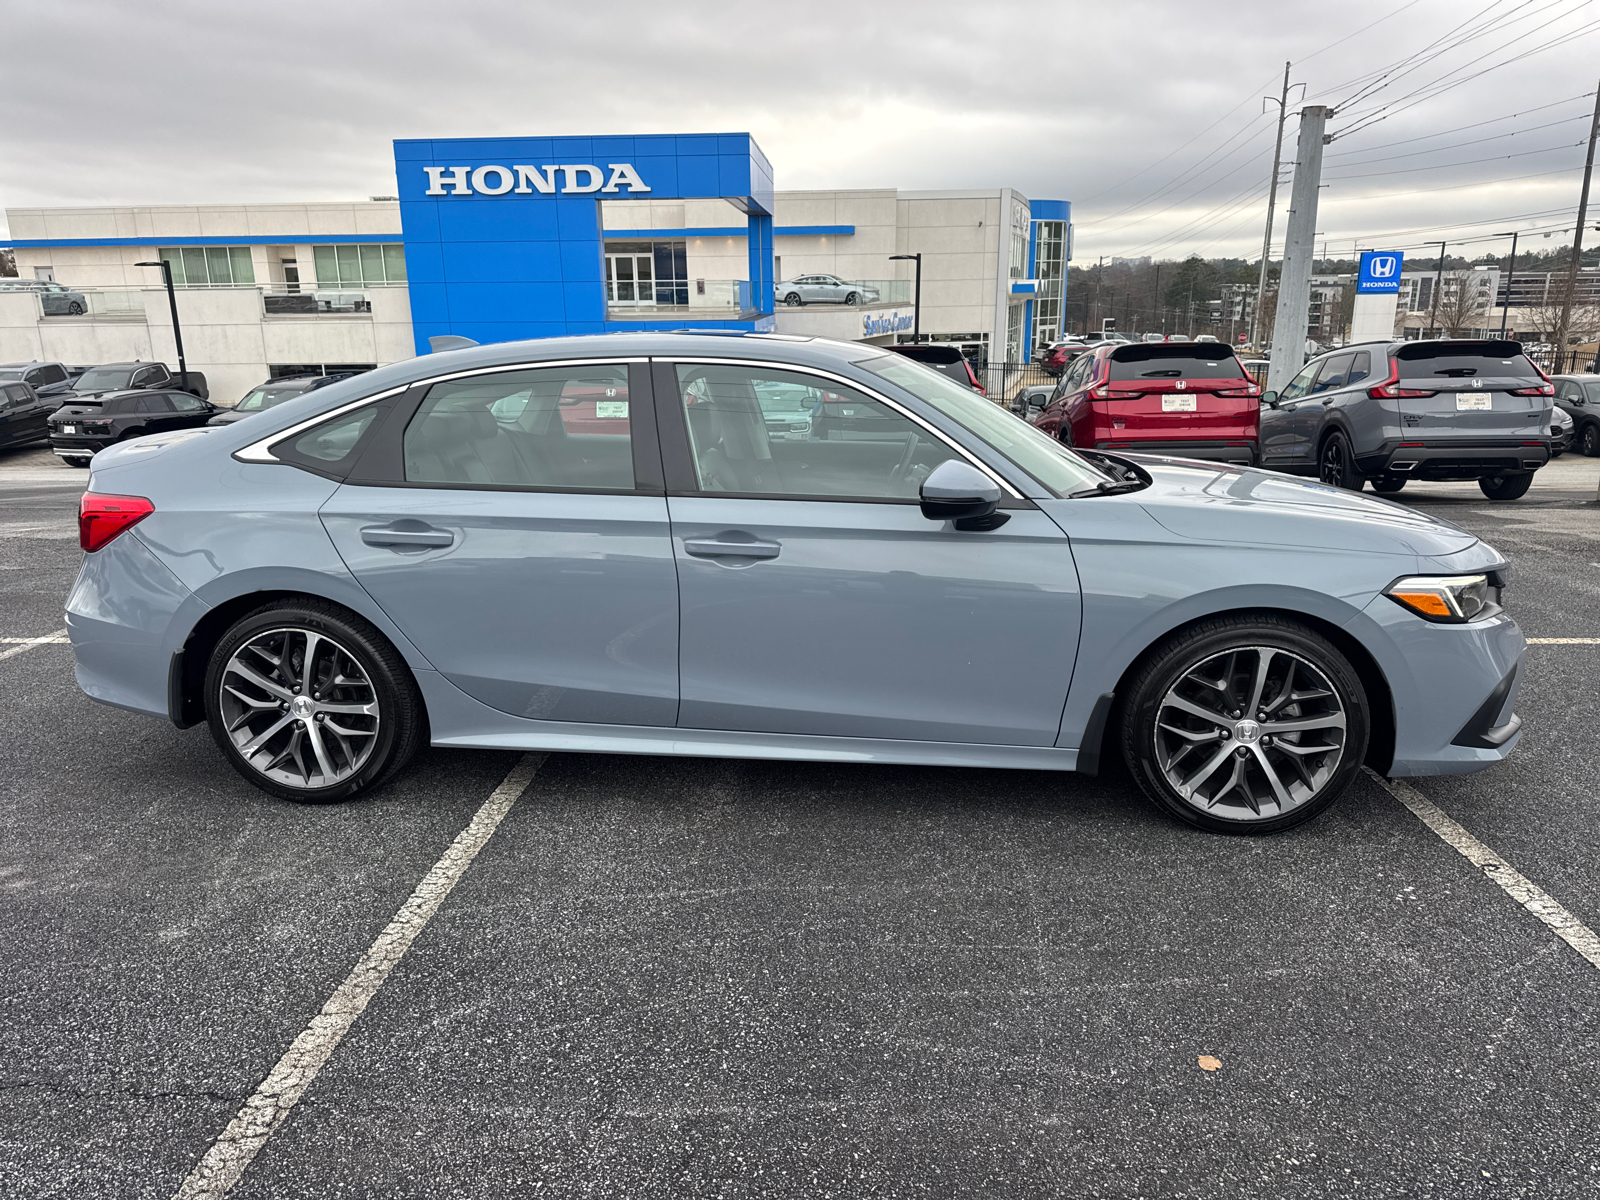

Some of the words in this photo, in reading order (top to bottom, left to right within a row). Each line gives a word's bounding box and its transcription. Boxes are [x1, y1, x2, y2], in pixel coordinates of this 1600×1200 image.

[423, 163, 651, 196] HONDA
[863, 313, 890, 336] Service
[890, 311, 913, 332] Center
[212, 634, 237, 665] KUMHO
